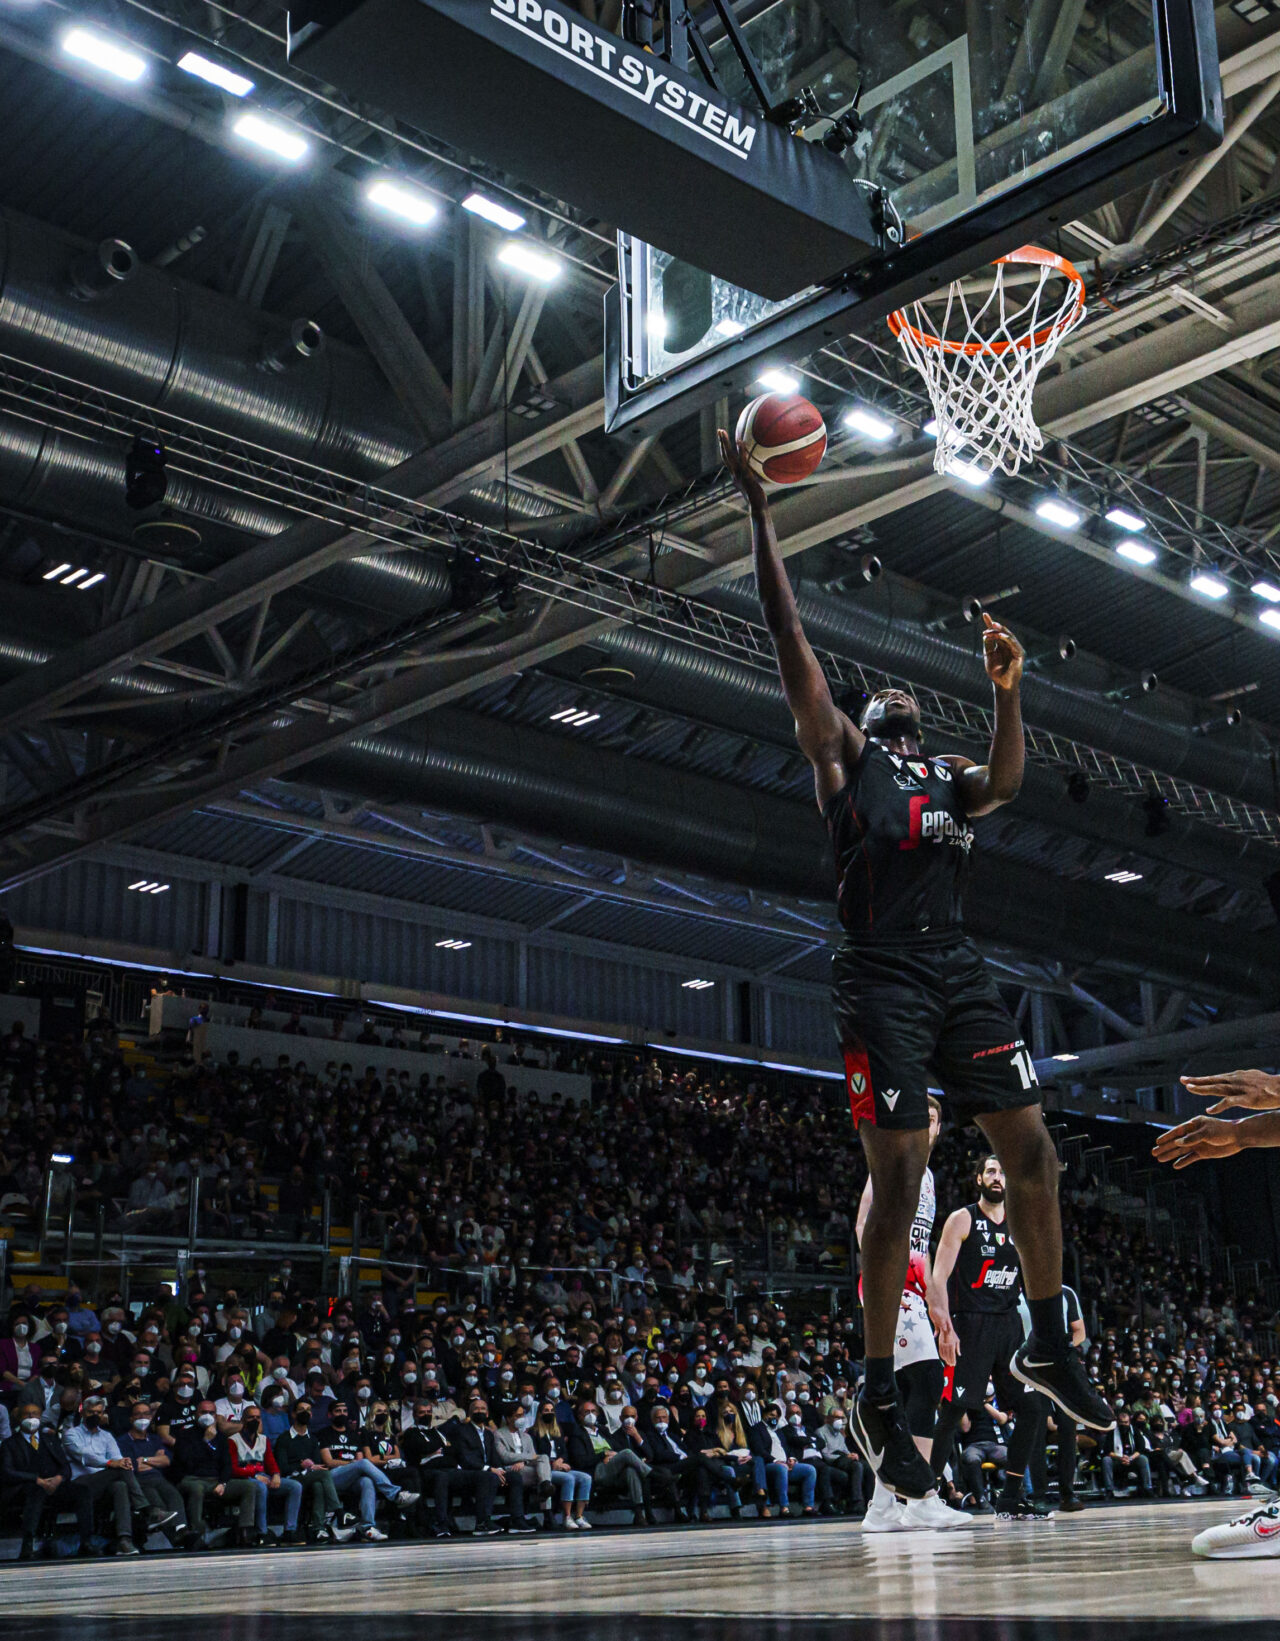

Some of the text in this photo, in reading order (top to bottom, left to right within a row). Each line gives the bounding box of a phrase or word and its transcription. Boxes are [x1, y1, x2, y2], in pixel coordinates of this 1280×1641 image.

[492, 0, 757, 152] SPORT SYSTEM
[976, 1220, 988, 1231] 21
